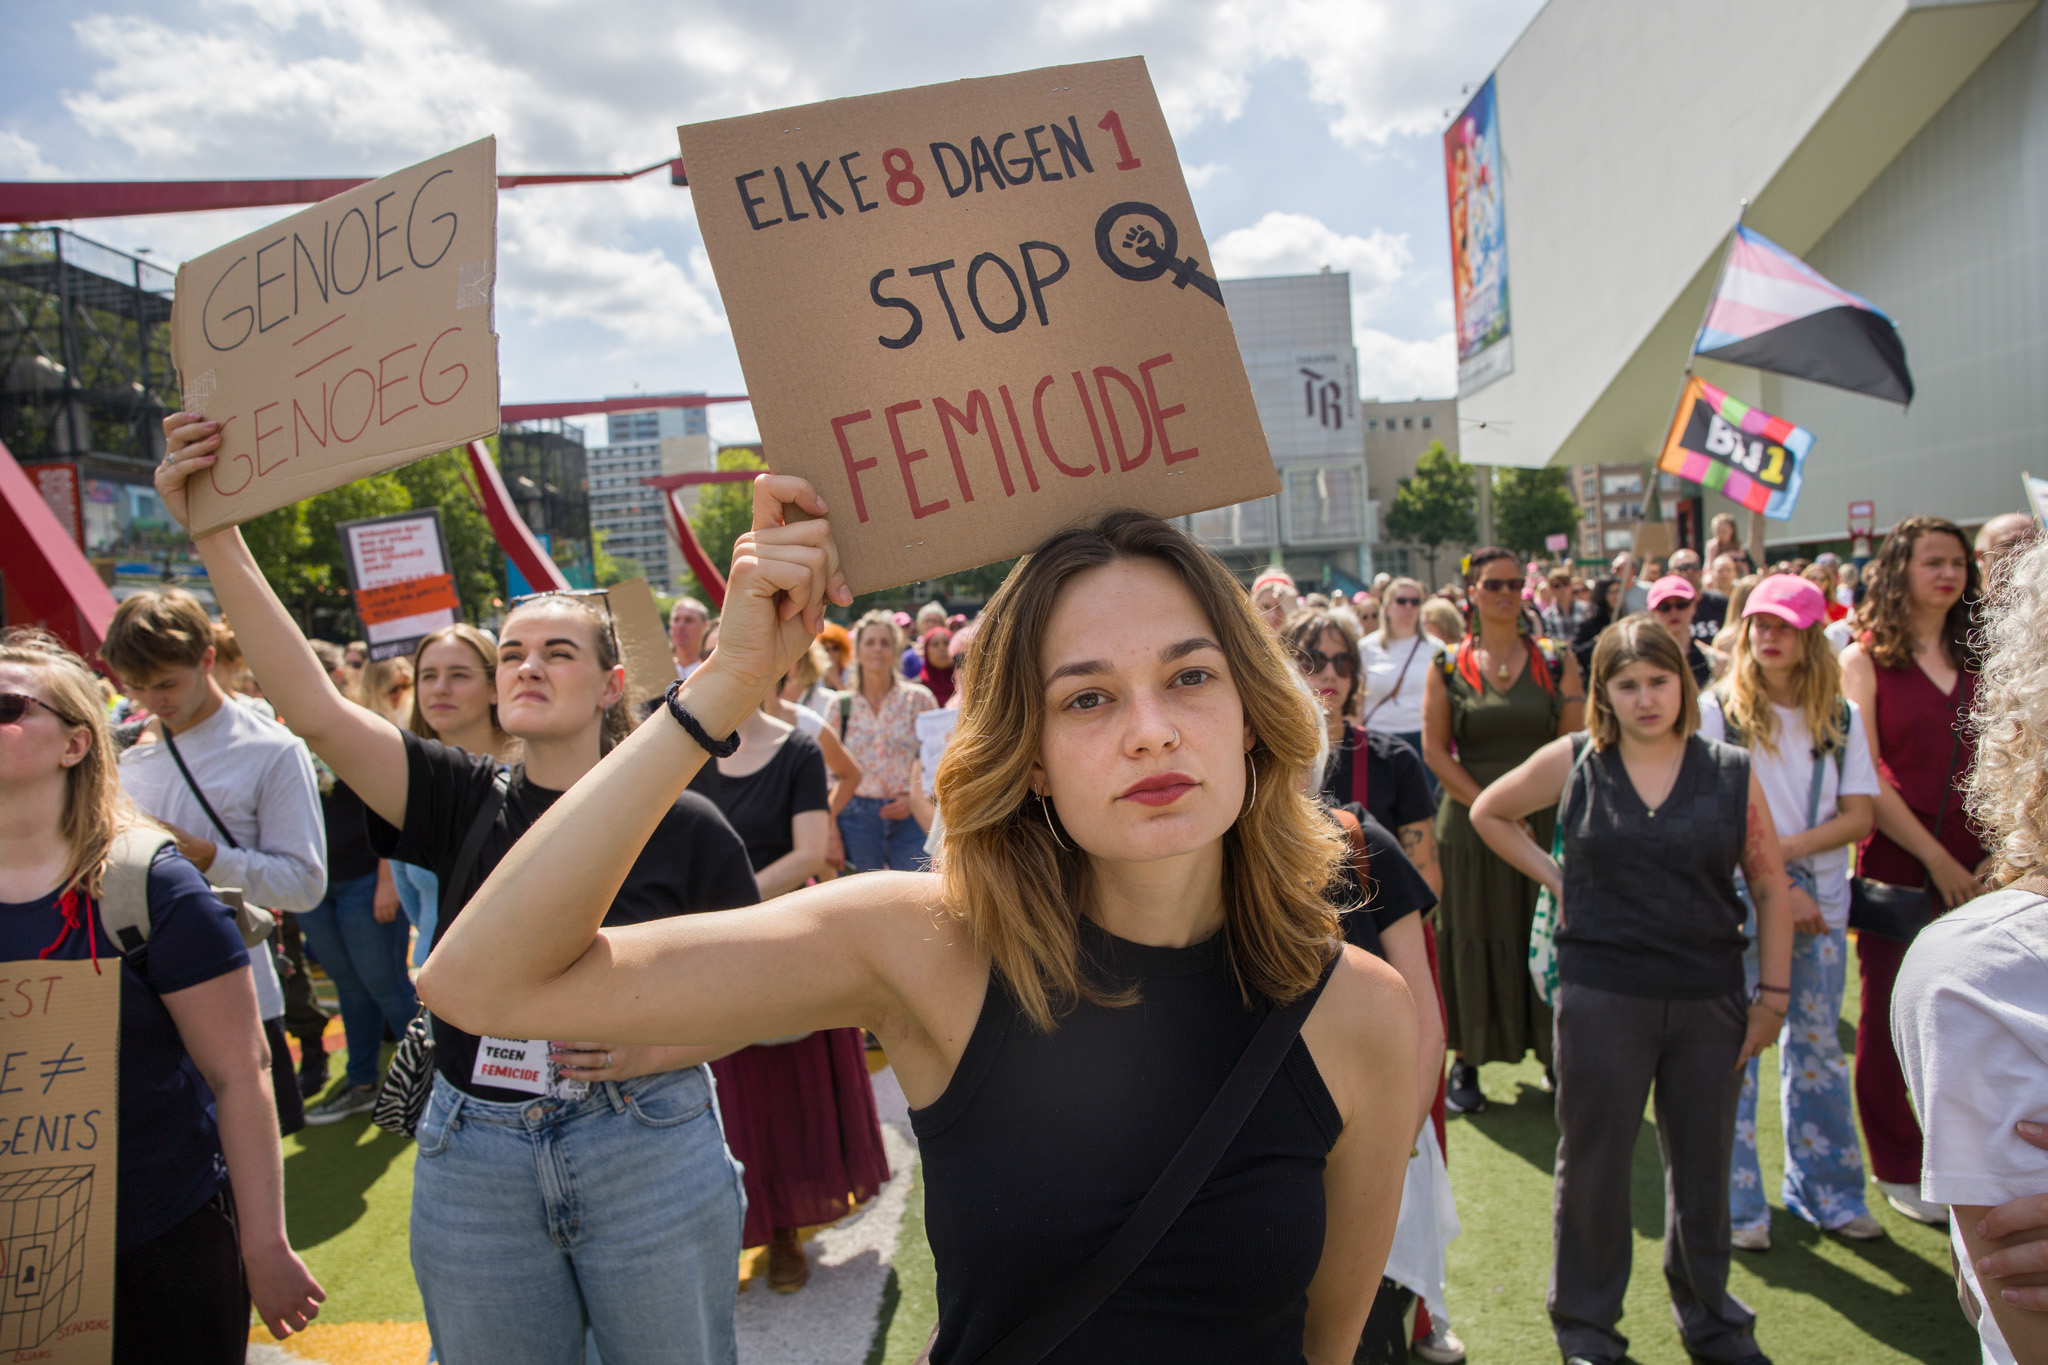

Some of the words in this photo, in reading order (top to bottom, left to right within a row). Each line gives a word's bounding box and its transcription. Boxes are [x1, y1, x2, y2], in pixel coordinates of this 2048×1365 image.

[735, 151, 879, 231] ELKE
[881, 147, 925, 207] 8
[929, 115, 1094, 199] DAGEN
[1097, 109, 1142, 172] 1
[202, 169, 458, 351] GENOEG
[870, 240, 1070, 349] STOP
[210, 326, 469, 497] GENOEG
[830, 352, 1200, 524] FEMICIDE
[481, 1063, 540, 1082] FEMICIDE
[486, 1046, 526, 1061] TEGEN
